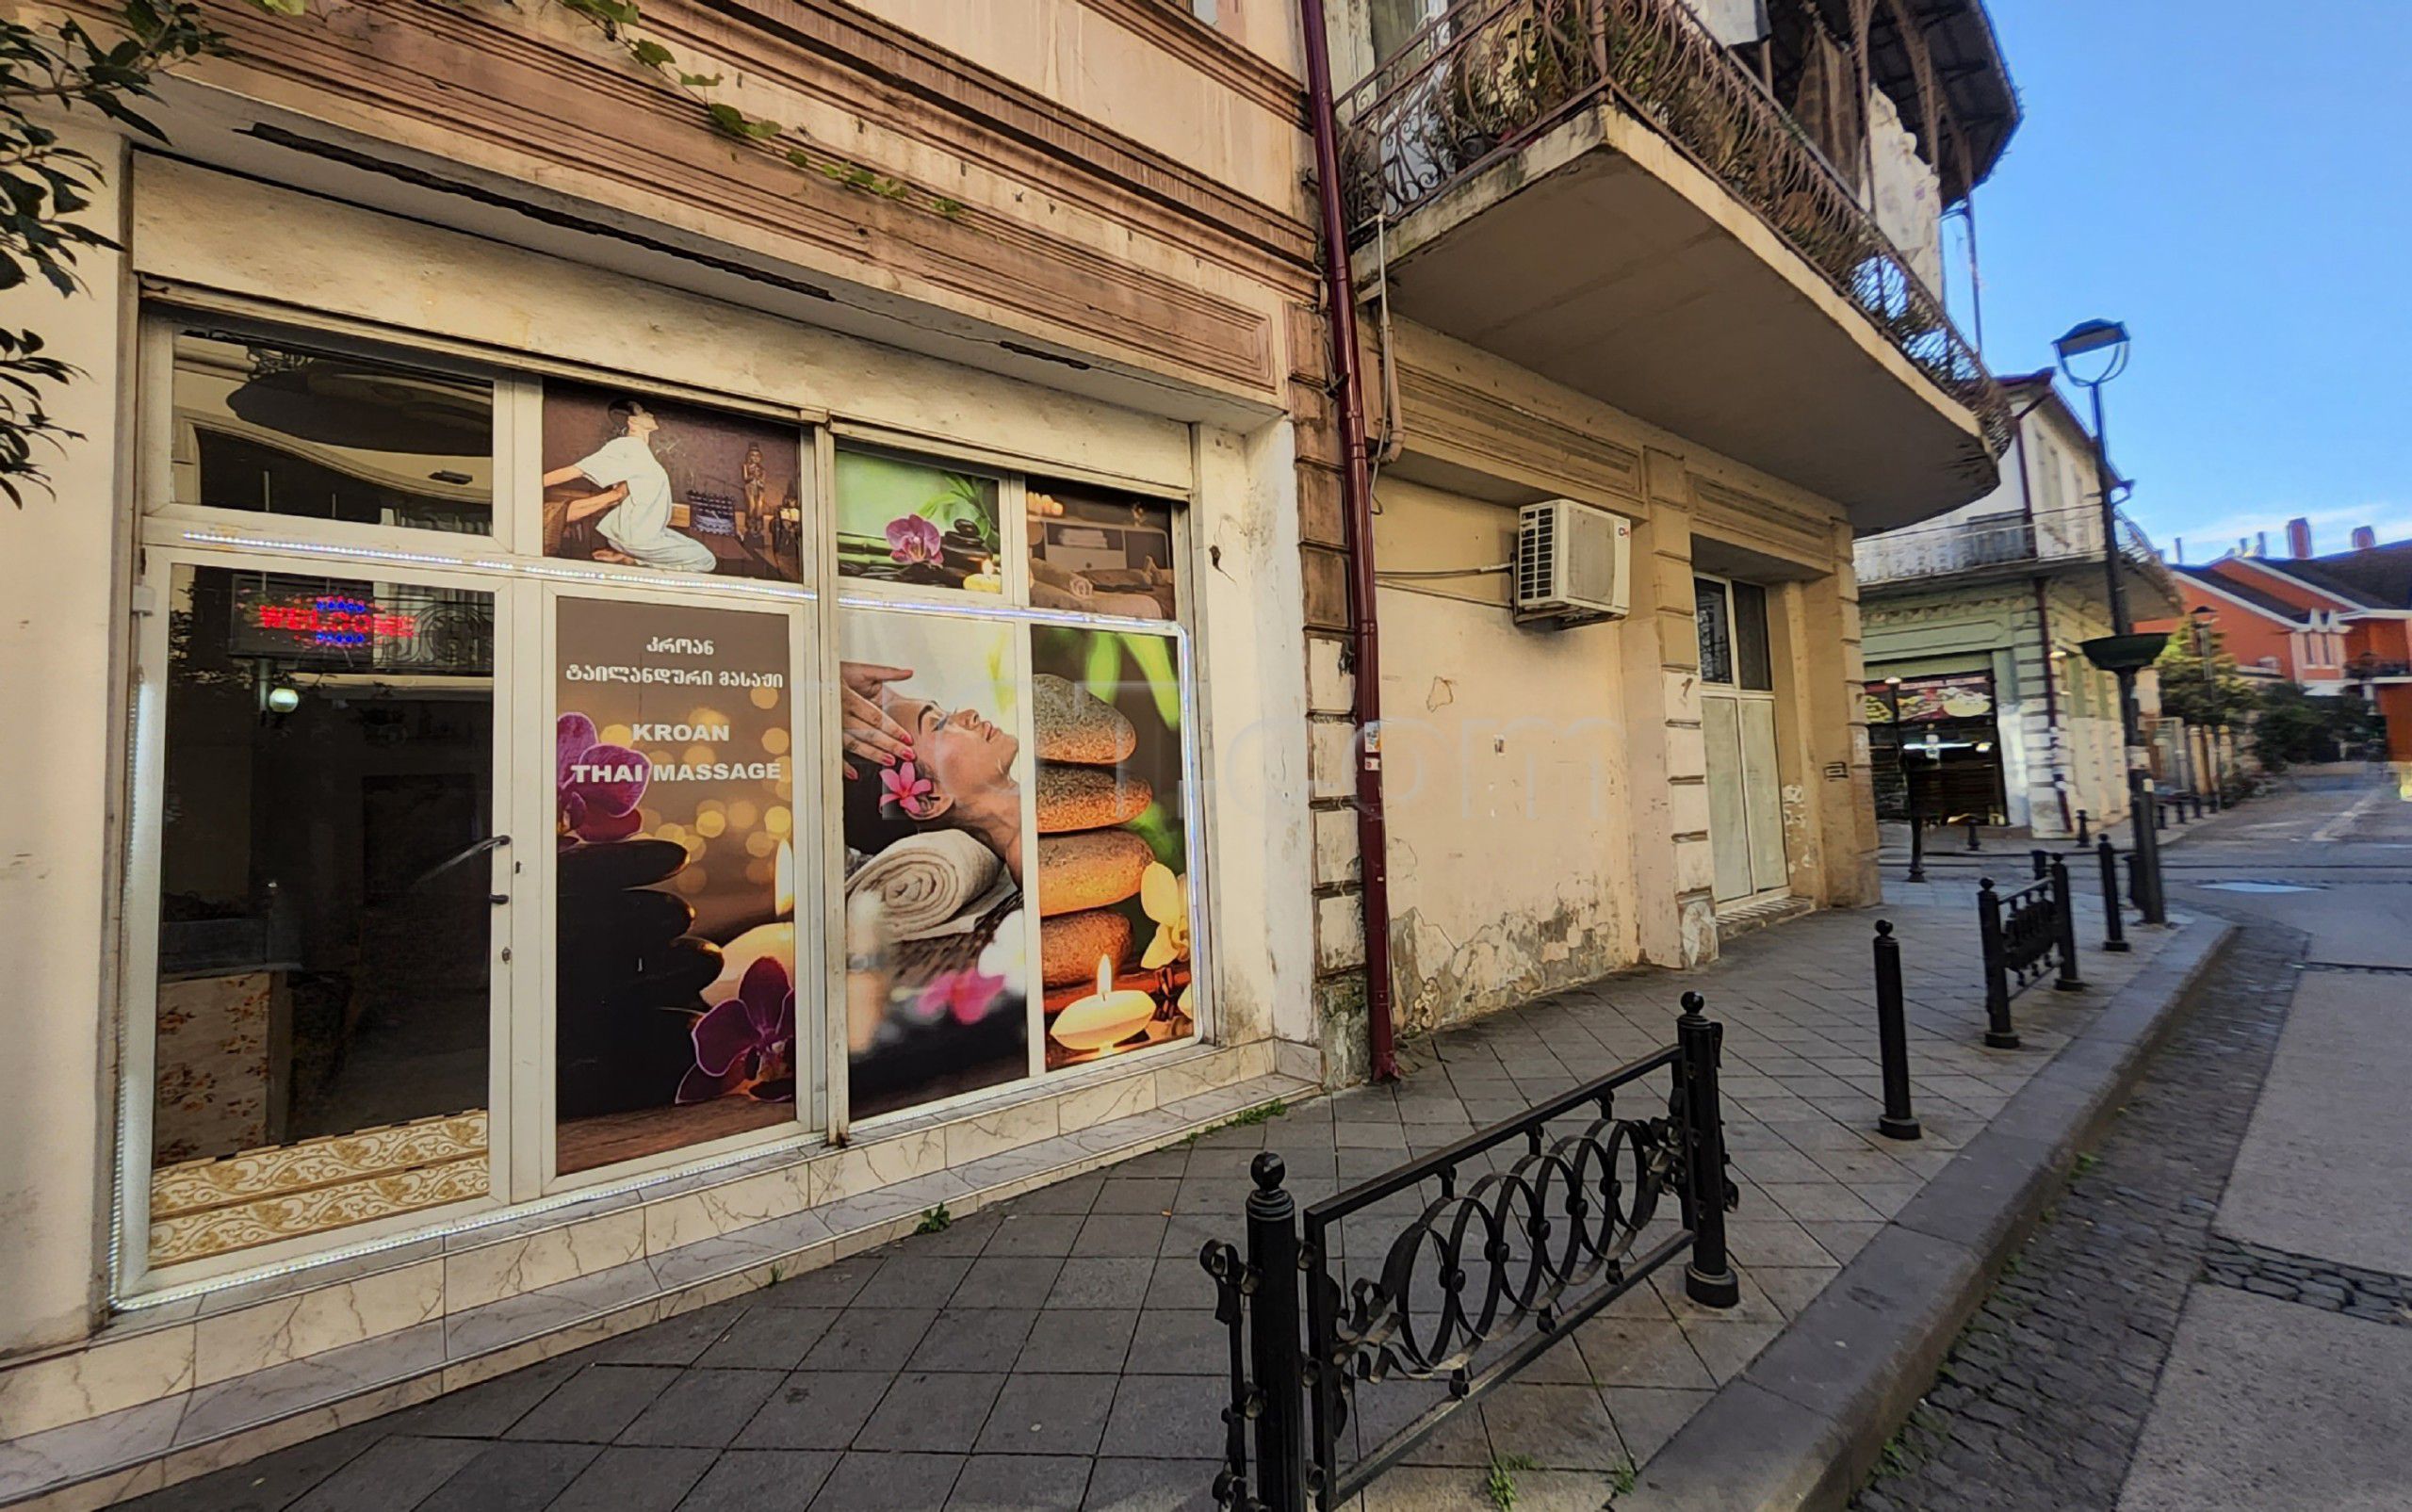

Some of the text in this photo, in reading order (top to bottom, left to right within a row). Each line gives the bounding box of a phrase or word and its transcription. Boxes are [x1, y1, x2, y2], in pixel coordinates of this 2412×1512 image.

[646, 636, 714, 656] კროან
[565, 663, 784, 689] ტაილანდური მასაჟი
[631, 723, 730, 742] KROAN
[571, 762, 782, 783] THAI MASSAGE
